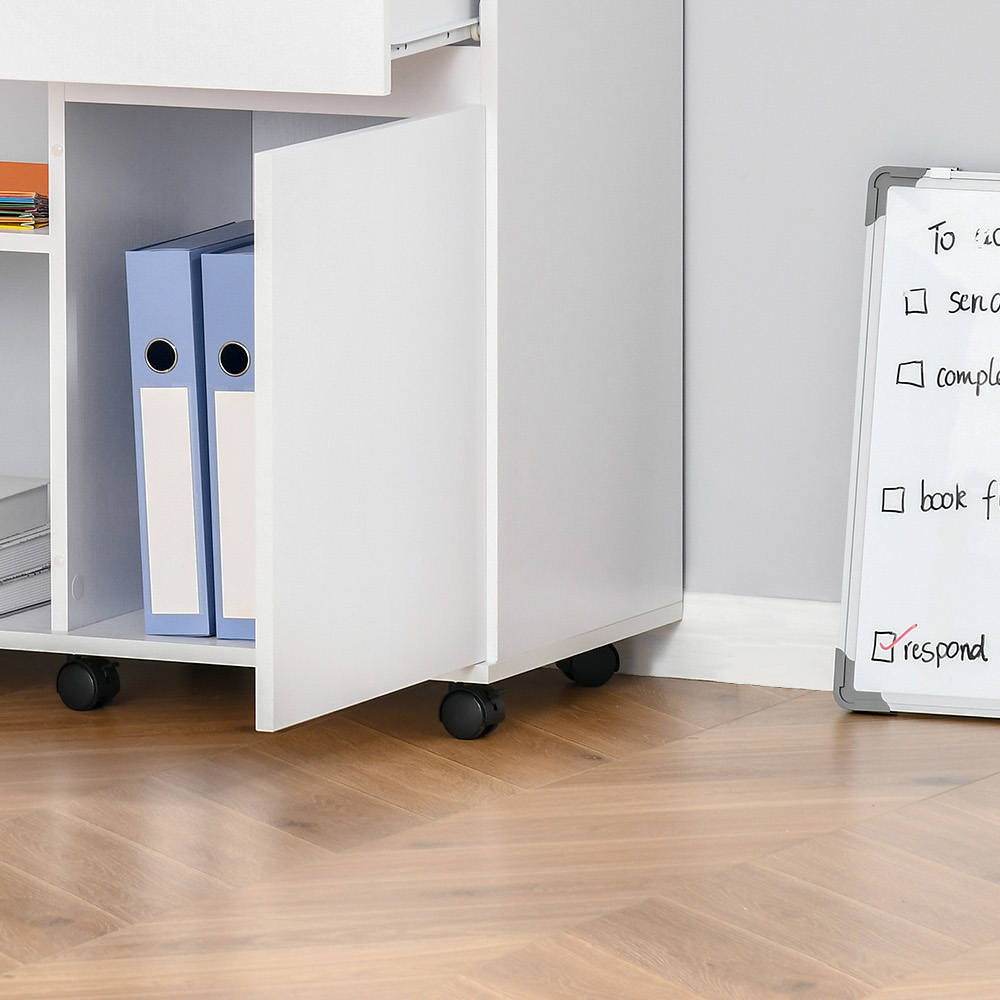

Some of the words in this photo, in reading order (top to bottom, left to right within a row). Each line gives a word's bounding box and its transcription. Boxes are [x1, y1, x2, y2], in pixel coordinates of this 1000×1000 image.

[928, 220, 956, 255] To
[920, 478, 968, 513] book
[903, 633, 989, 669] respond
